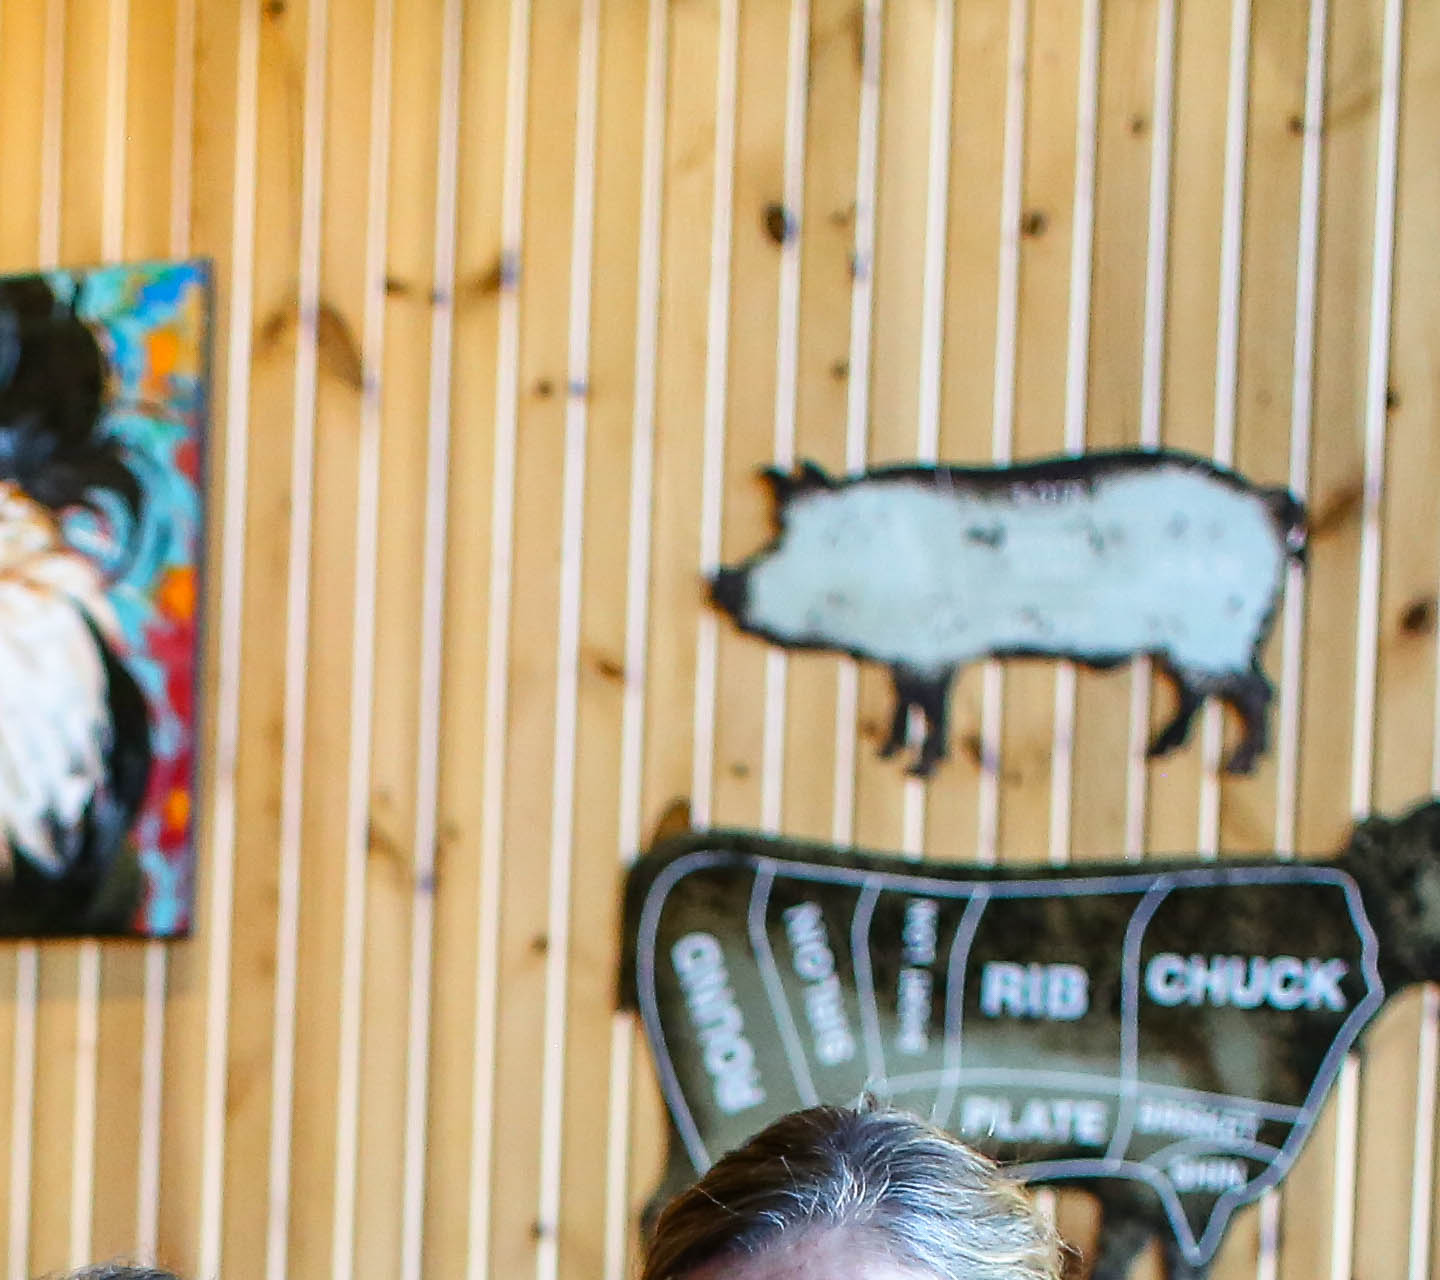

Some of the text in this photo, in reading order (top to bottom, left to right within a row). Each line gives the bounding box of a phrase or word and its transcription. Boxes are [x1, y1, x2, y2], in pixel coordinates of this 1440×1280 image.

[980, 960, 1089, 1021] RIB
[1145, 952, 1349, 1011] CHUCK
[671, 932, 766, 1114] ROUND
[959, 1098, 1108, 1146] PLATE
